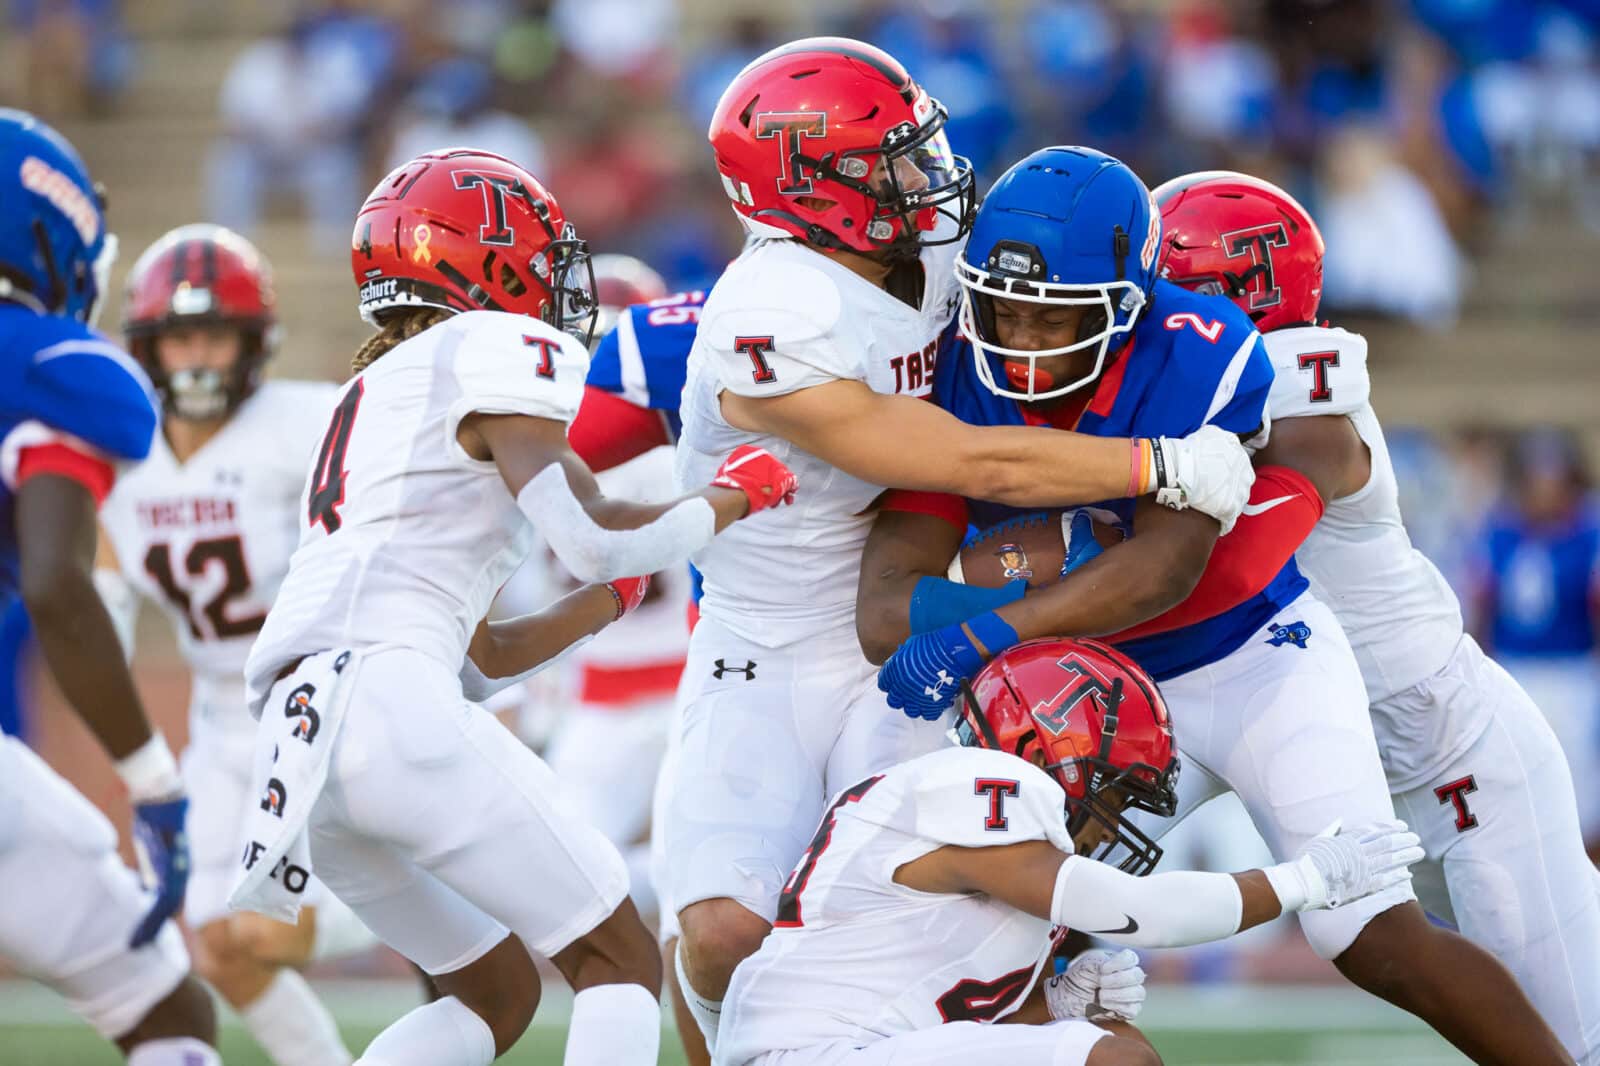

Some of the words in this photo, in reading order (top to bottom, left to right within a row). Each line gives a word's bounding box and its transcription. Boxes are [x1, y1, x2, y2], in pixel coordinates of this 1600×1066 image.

[756, 111, 826, 194] T
[451, 169, 524, 246] T
[360, 223, 371, 259] 4
[1221, 222, 1289, 310] T
[360, 279, 397, 301] schutt
[1164, 312, 1226, 344] 2
[521, 334, 561, 381] T
[734, 335, 777, 384] T
[1297, 350, 1340, 403] T
[308, 375, 363, 535] 4
[144, 534, 269, 641] 12
[1032, 651, 1125, 736] T
[974, 778, 1020, 831] T
[1433, 773, 1479, 833] T
